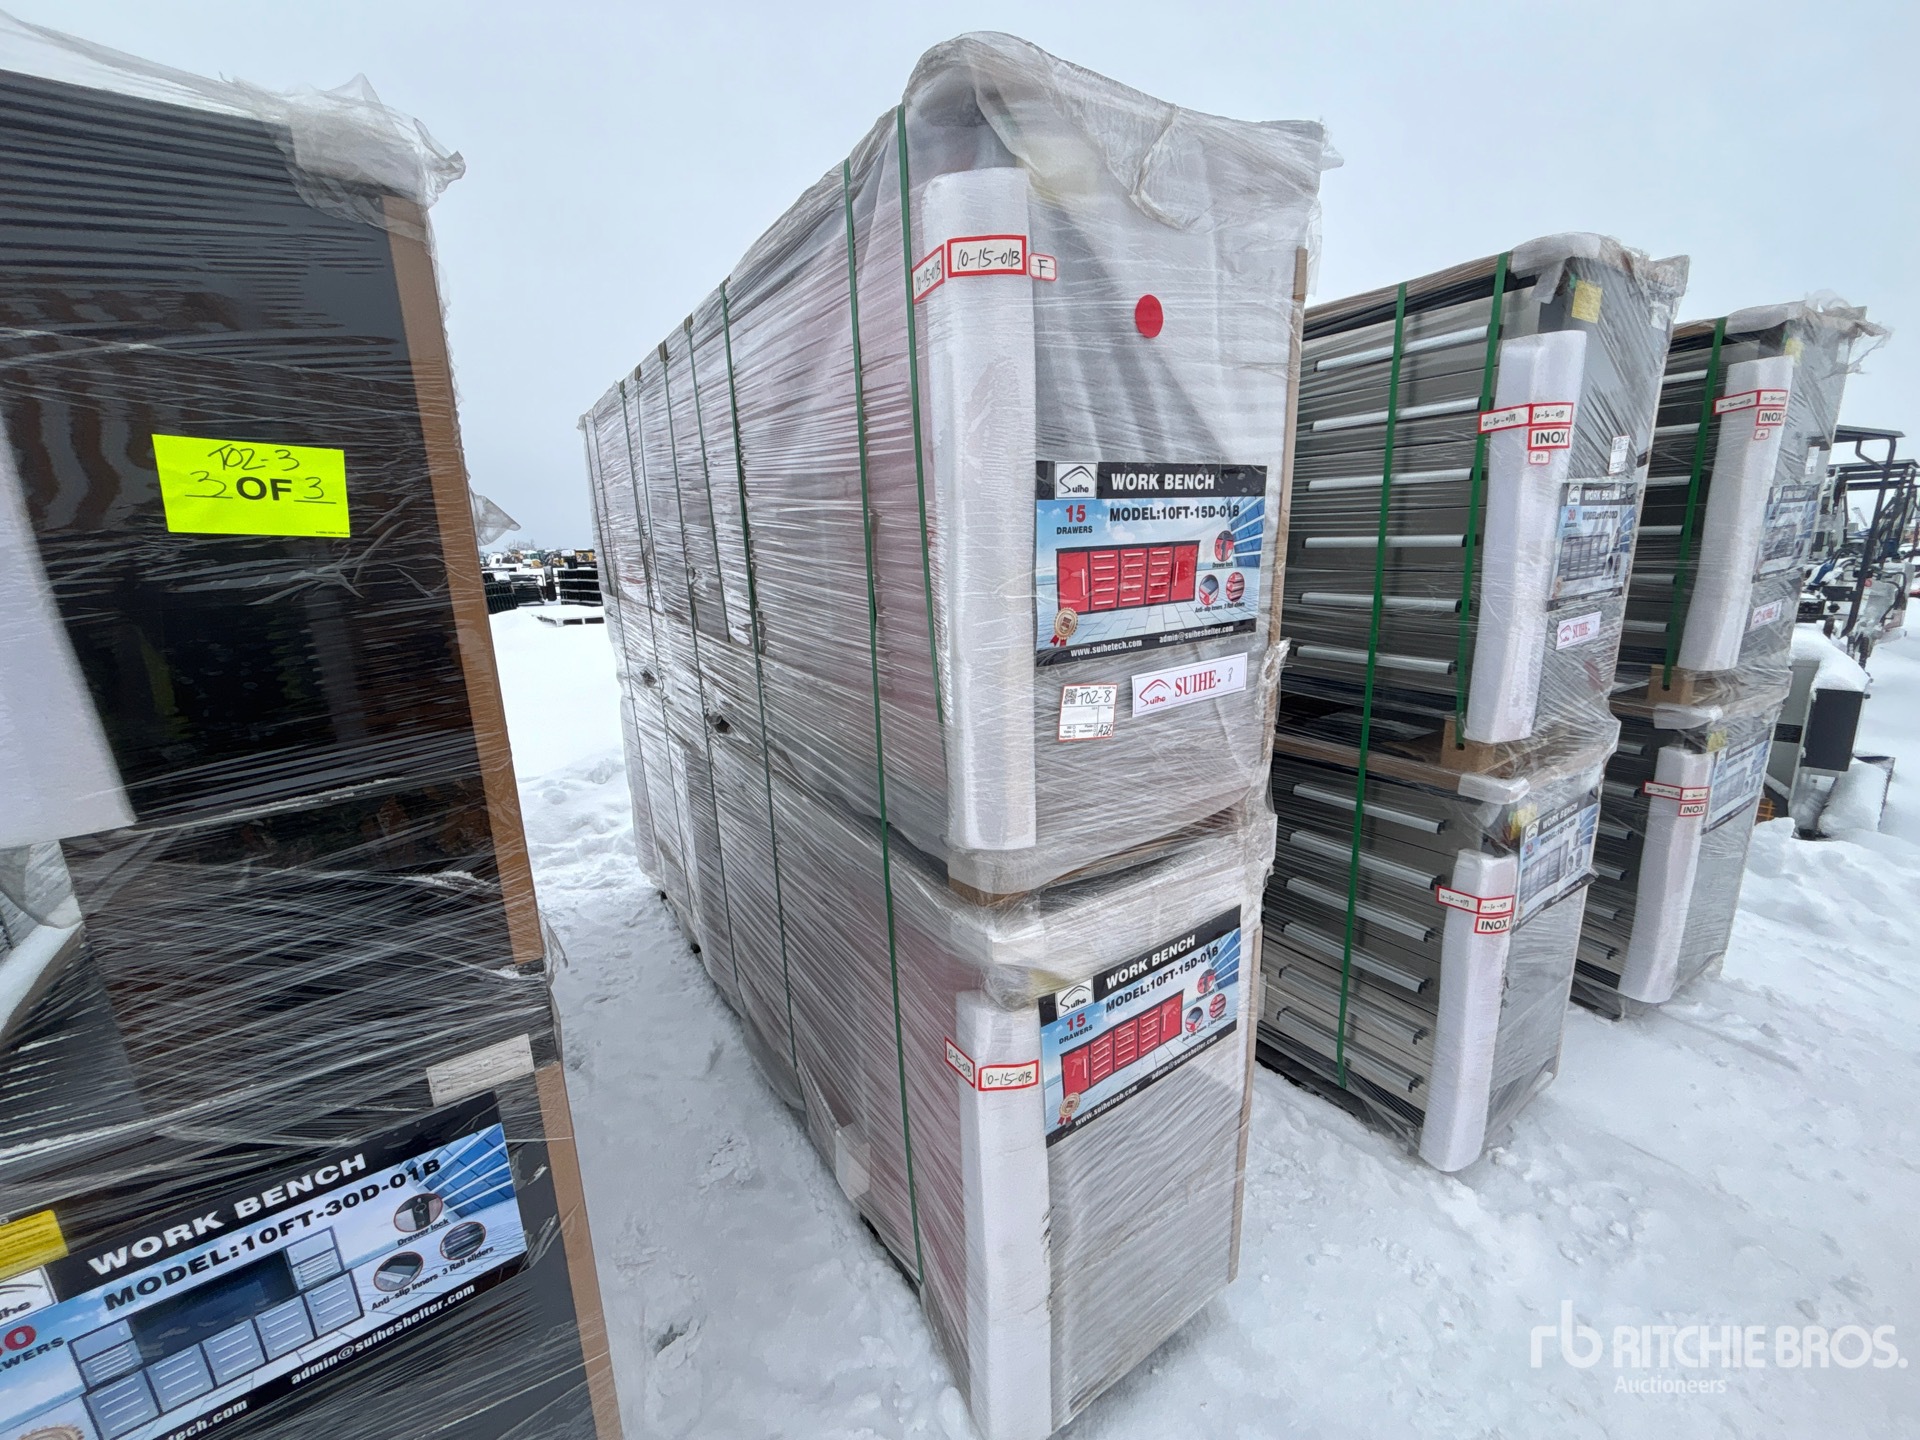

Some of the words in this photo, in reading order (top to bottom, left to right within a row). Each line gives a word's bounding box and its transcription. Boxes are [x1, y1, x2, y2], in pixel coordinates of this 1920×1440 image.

[957, 247, 1021, 270] 10-15-01B
[1761, 412, 1782, 421] INOX
[1535, 431, 1566, 444] INOX
[190, 470, 227, 498] 3
[236, 476, 292, 501] OF
[303, 476, 324, 499] 3
[1111, 473, 1160, 490] WORK
[1164, 473, 1215, 490] BENCH
[1065, 504, 1086, 523] 15
[1056, 525, 1093, 535] DRAWERS
[1071, 639, 1142, 657] www.suihetech.com
[1683, 805, 1704, 813] INOX
[1481, 919, 1508, 930] INOX
[1106, 959, 1148, 990] WORK
[1151, 934, 1196, 967] BENCH
[1066, 1013, 1087, 1032] 15
[1059, 1024, 1093, 1045] DRAWERS
[88, 1213, 226, 1276] WORK
[235, 1153, 366, 1219] BENCH
[104, 1159, 440, 1311] MODEL:10FT-30D-01B
[397, 1228, 429, 1247] Drawer
[430, 1218, 449, 1230] lock
[450, 1260, 466, 1271] Rail
[467, 1246, 494, 1263] sliders
[372, 1287, 410, 1310] Anti-slip
[412, 1274, 438, 1290] inners
[291, 1282, 475, 1385] admin@suiheshelter.com
[0, 1337, 64, 1372] WERS
